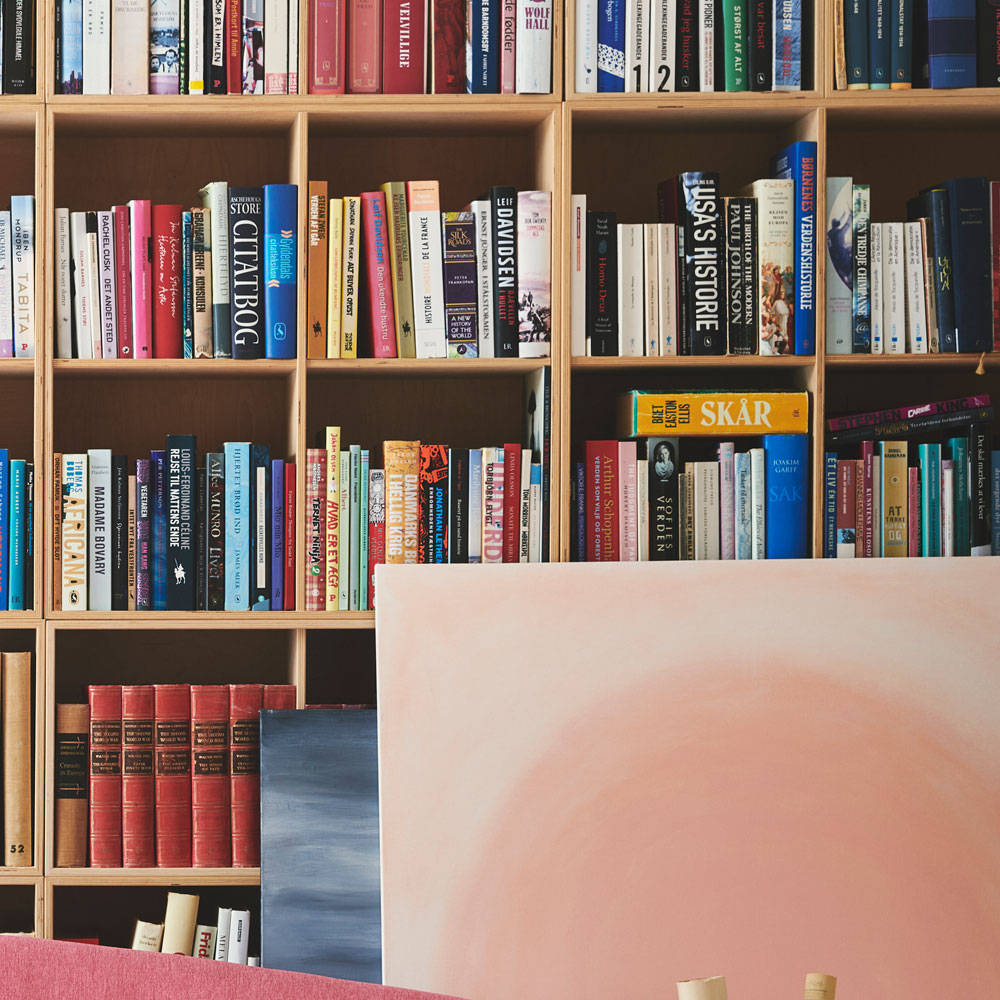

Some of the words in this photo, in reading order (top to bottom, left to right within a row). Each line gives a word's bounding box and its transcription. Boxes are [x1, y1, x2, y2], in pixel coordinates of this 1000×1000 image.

[525, 7, 551, 18] WOLF
[525, 19, 549, 30] HALL
[679, 18, 692, 33] jeg
[733, 6, 742, 38] STØRST
[399, 2, 410, 68] VELVILLIGE
[503, 16, 516, 52] fødder
[734, 43, 742, 53] AF
[681, 36, 693, 70] husker
[734, 58, 742, 72] ALT
[633, 64, 642, 92] 1
[657, 65, 671, 92] 2
[801, 157, 814, 211] BØRNENES
[230, 202, 261, 215] STORE
[730, 204, 742, 243] PAUL
[102, 216, 110, 248] RACHEL
[498, 209, 514, 287] DAVIDSEN
[103, 249, 111, 271] CUSK
[218, 234, 230, 296] HJERTELYD
[278, 238, 294, 279] Gyldendals
[799, 215, 813, 310] VERDENSHISTORIE
[855, 234, 867, 266] TREDJE
[232, 219, 260, 345] CITATBOG
[599, 258, 608, 286] Homo
[728, 246, 742, 324] JOHNSON
[18, 273, 30, 335] TABITA
[599, 289, 608, 312] Deus
[694, 247, 719, 331] HISTORIE
[856, 268, 868, 316] CHIMPANSE
[105, 295, 113, 320] ANDET
[652, 405, 664, 424] BRET
[665, 400, 677, 429] EASTON
[678, 403, 690, 424] ELLIS
[700, 398, 772, 428] SKÅR
[170, 449, 180, 473] REJSE
[170, 475, 180, 486] TIL
[181, 449, 191, 520] LOUIS-FERDINAND
[769, 486, 803, 501] SAK
[95, 487, 105, 532] MADAME
[170, 489, 180, 524] NATTENS
[405, 474, 418, 547] DANMARKS
[170, 527, 180, 547] ENDE
[181, 522, 193, 550] CÉLINE
[657, 496, 665, 551] VERDEN
[665, 498, 673, 549] SOFIES
[64, 496, 86, 587] AFRICANA
[95, 536, 105, 575] BOVARY
[10, 844, 25, 854] 52
